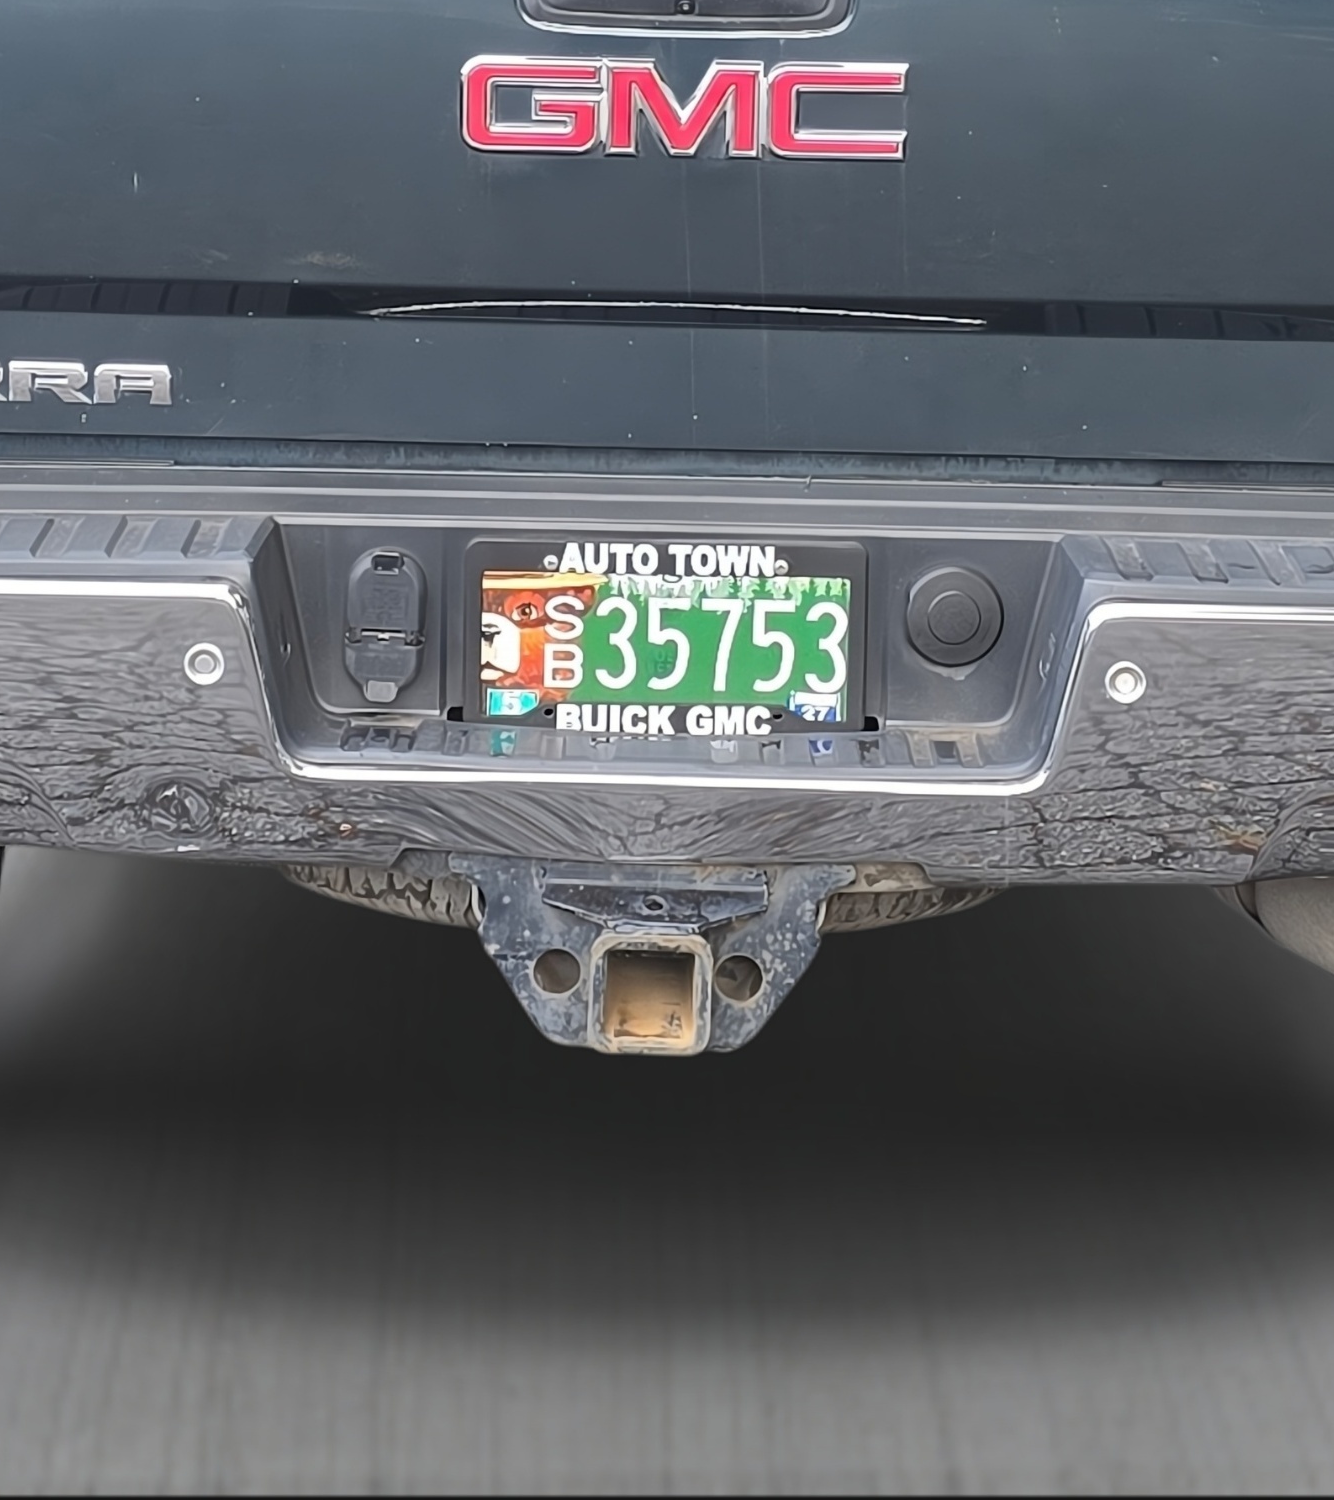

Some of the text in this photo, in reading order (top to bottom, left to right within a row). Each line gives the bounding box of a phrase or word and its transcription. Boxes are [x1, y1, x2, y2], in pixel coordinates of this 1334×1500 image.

[461, 54, 910, 160] GMC
[559, 542, 776, 577] AUTO TOWN
[595, 596, 849, 693] 35753
[556, 704, 773, 735] BUICK GMC
